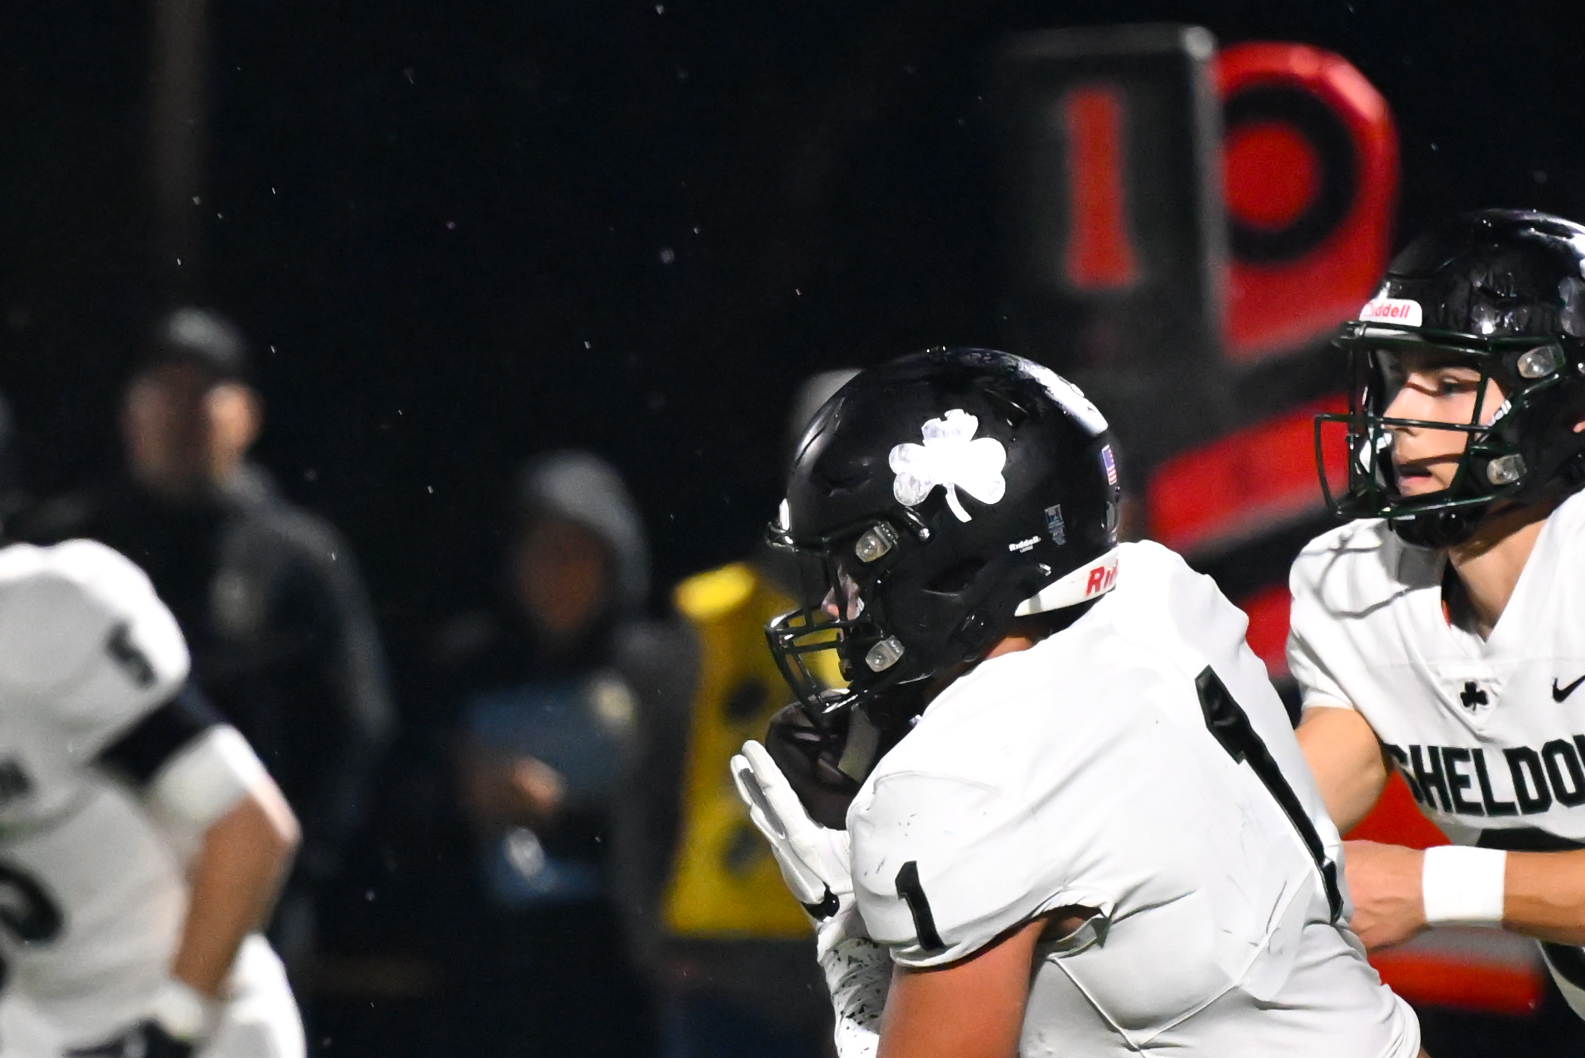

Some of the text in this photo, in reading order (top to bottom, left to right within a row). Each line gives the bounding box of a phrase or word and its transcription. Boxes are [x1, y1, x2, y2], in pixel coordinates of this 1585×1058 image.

[1365, 303, 1411, 319] ddell
[1195, 664, 1344, 924] 1
[895, 861, 945, 951] 1
